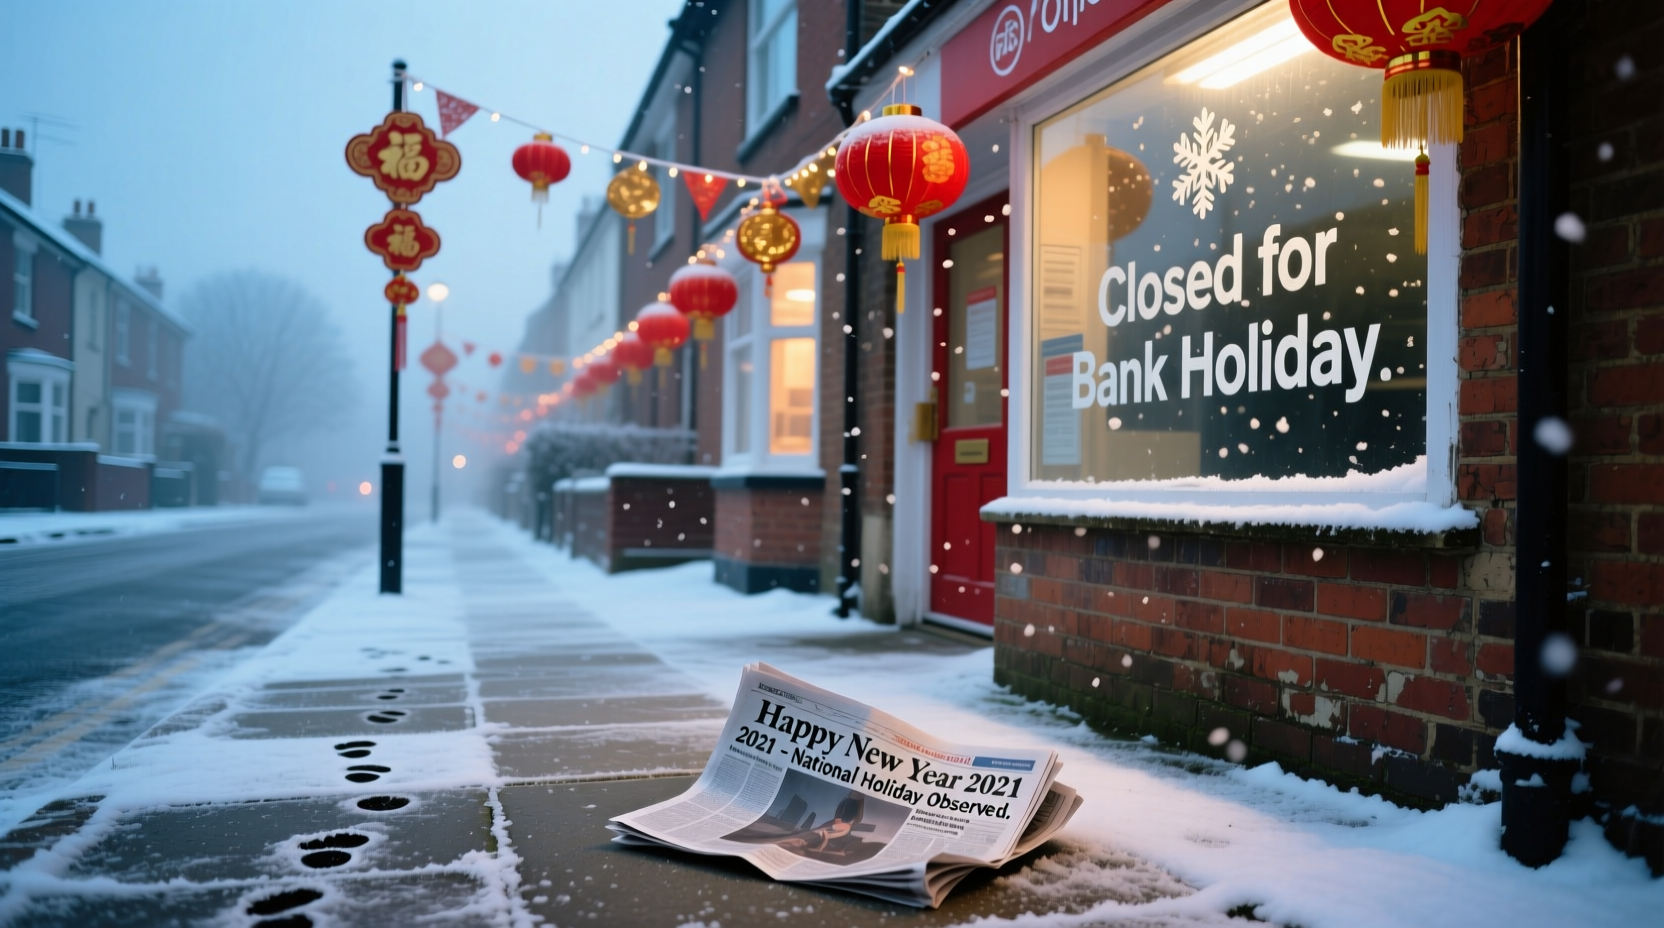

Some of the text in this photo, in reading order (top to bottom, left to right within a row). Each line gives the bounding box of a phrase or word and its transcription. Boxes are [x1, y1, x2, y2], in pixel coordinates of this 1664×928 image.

[378, 131, 430, 181] 福
[1098, 233, 1243, 327] Closed
[1258, 224, 1337, 296] for
[1072, 340, 1168, 409] Bank
[735, 726, 776, 754] 2021
[791, 747, 860, 784] National
[860, 771, 923, 805] Holiday
[926, 792, 1011, 820] Observed.
[754, 699, 845, 755] Happy
[844, 732, 904, 772] New
[907, 757, 962, 789] Year
[964, 773, 1023, 798] 2021
